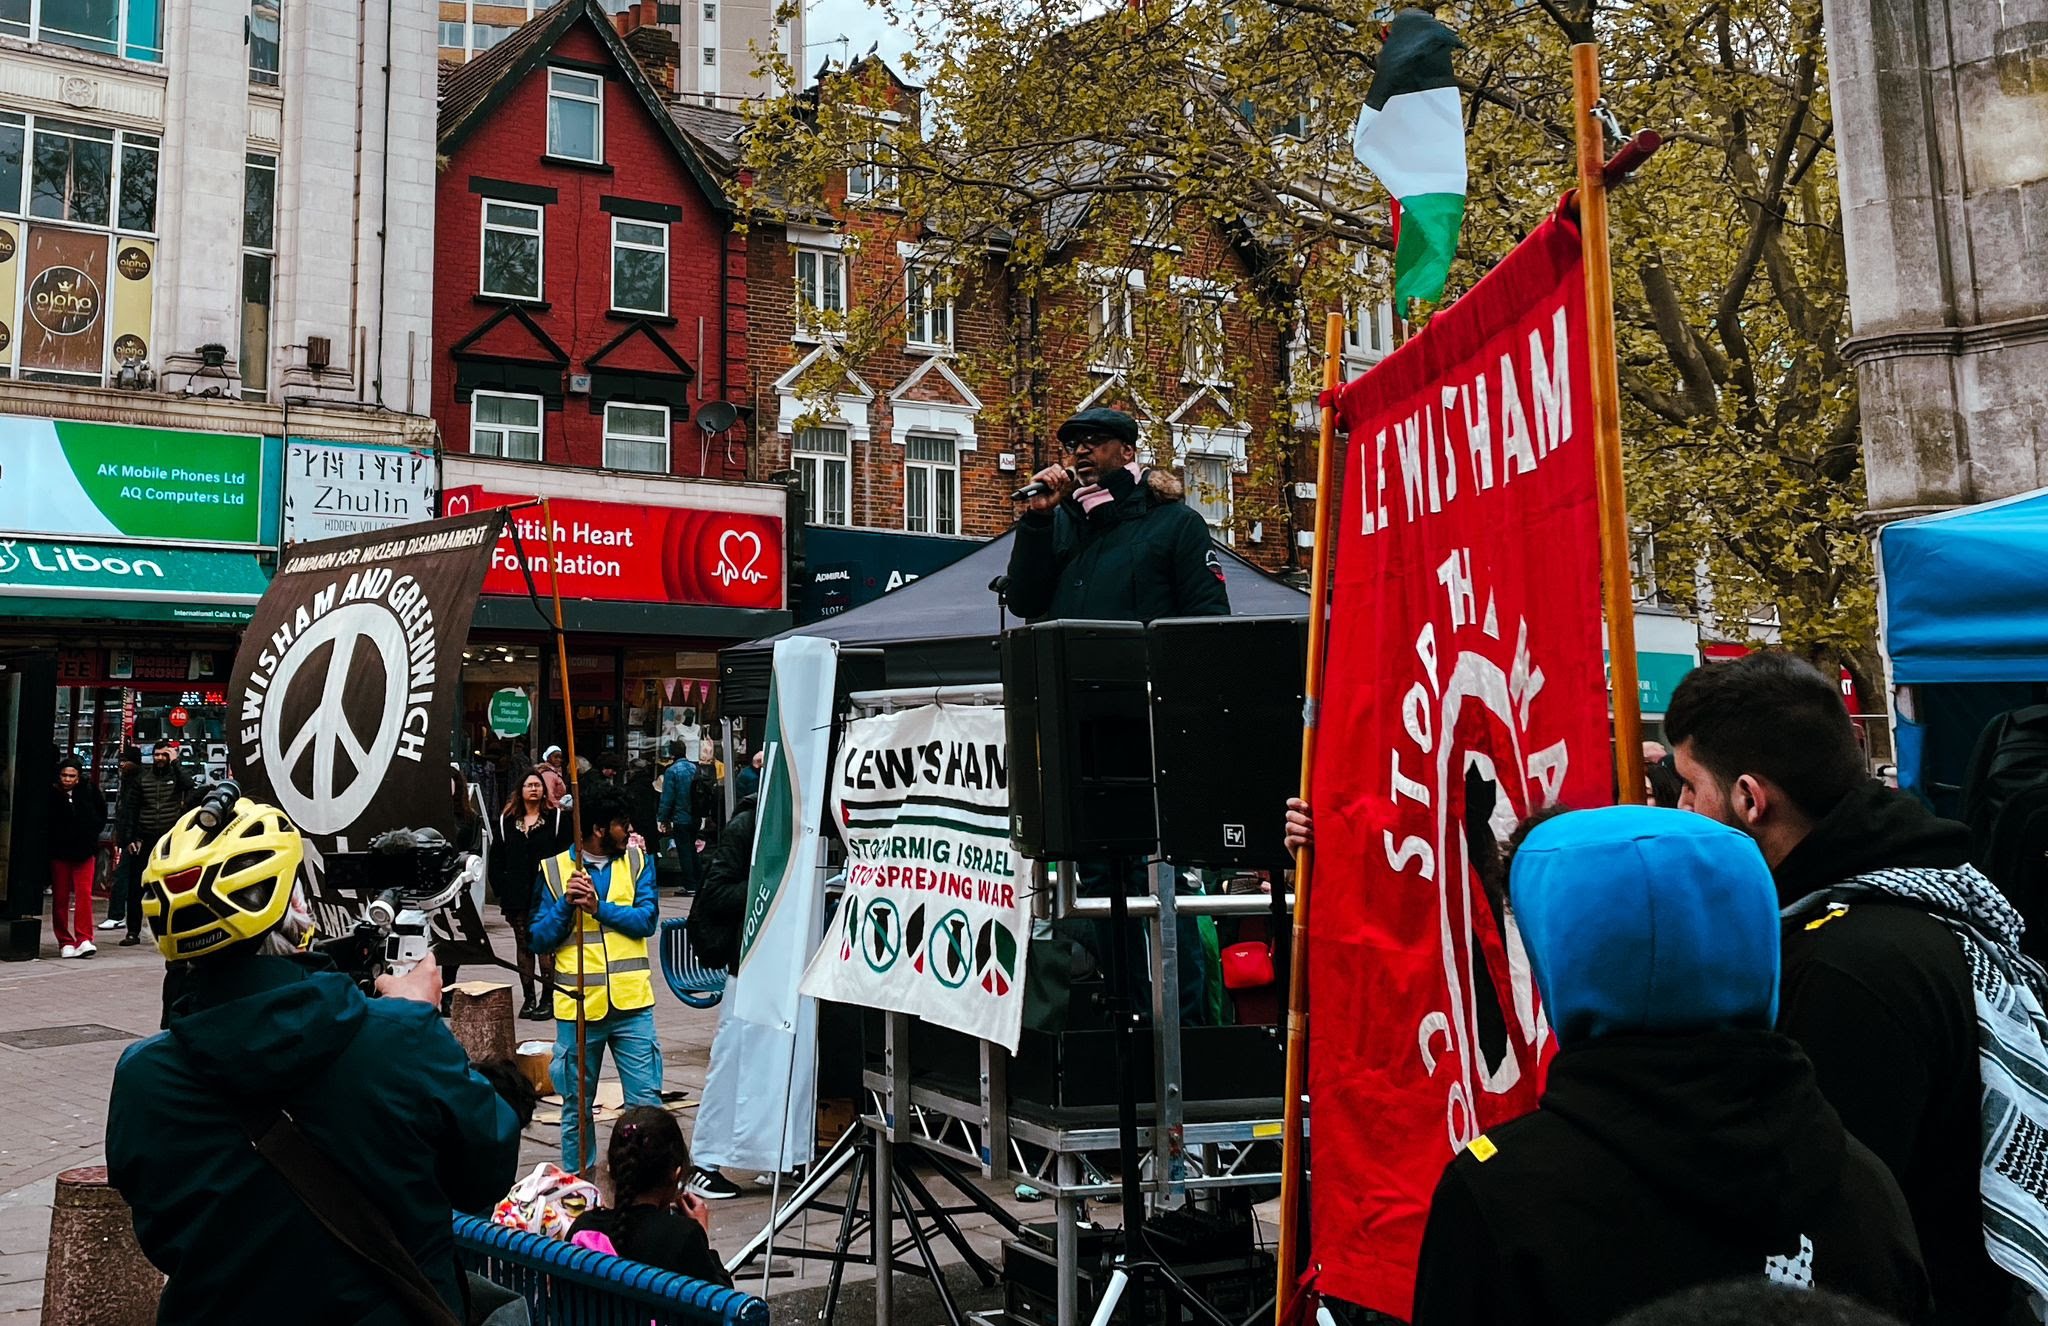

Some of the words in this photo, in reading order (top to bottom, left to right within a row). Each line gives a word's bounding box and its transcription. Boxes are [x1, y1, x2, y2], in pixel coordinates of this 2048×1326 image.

[1360, 304, 1573, 536] LEWISHAM
[97, 464, 118, 476] AK
[121, 466, 168, 480] Mobile
[171, 469, 220, 483] Phones
[224, 472, 245, 485] Ltd
[120, 486, 142, 500] AQ
[145, 488, 219, 504] Computers
[223, 493, 244, 505] Ltd
[314, 485, 409, 515] Zhulin
[324, 519, 357, 533] HIDDEN
[573, 522, 634, 547] Heart
[27, 546, 165, 577] Libon
[284, 552, 337, 575] CAMPAIGN
[335, 549, 361, 567] FOR
[360, 541, 405, 563] NUCLEAR
[406, 525, 488, 555] DISARMAMENT
[815, 570, 850, 584] ADMIRAL
[173, 609, 214, 617] International
[214, 610, 231, 618] Calls
[241, 582, 337, 767] LEWISHAM
[339, 568, 393, 605] AND
[388, 575, 436, 763] GREENWICH
[957, 843, 1015, 877] ISRAEL
[978, 879, 1015, 909] WAR
[743, 883, 771, 947] VOICE
